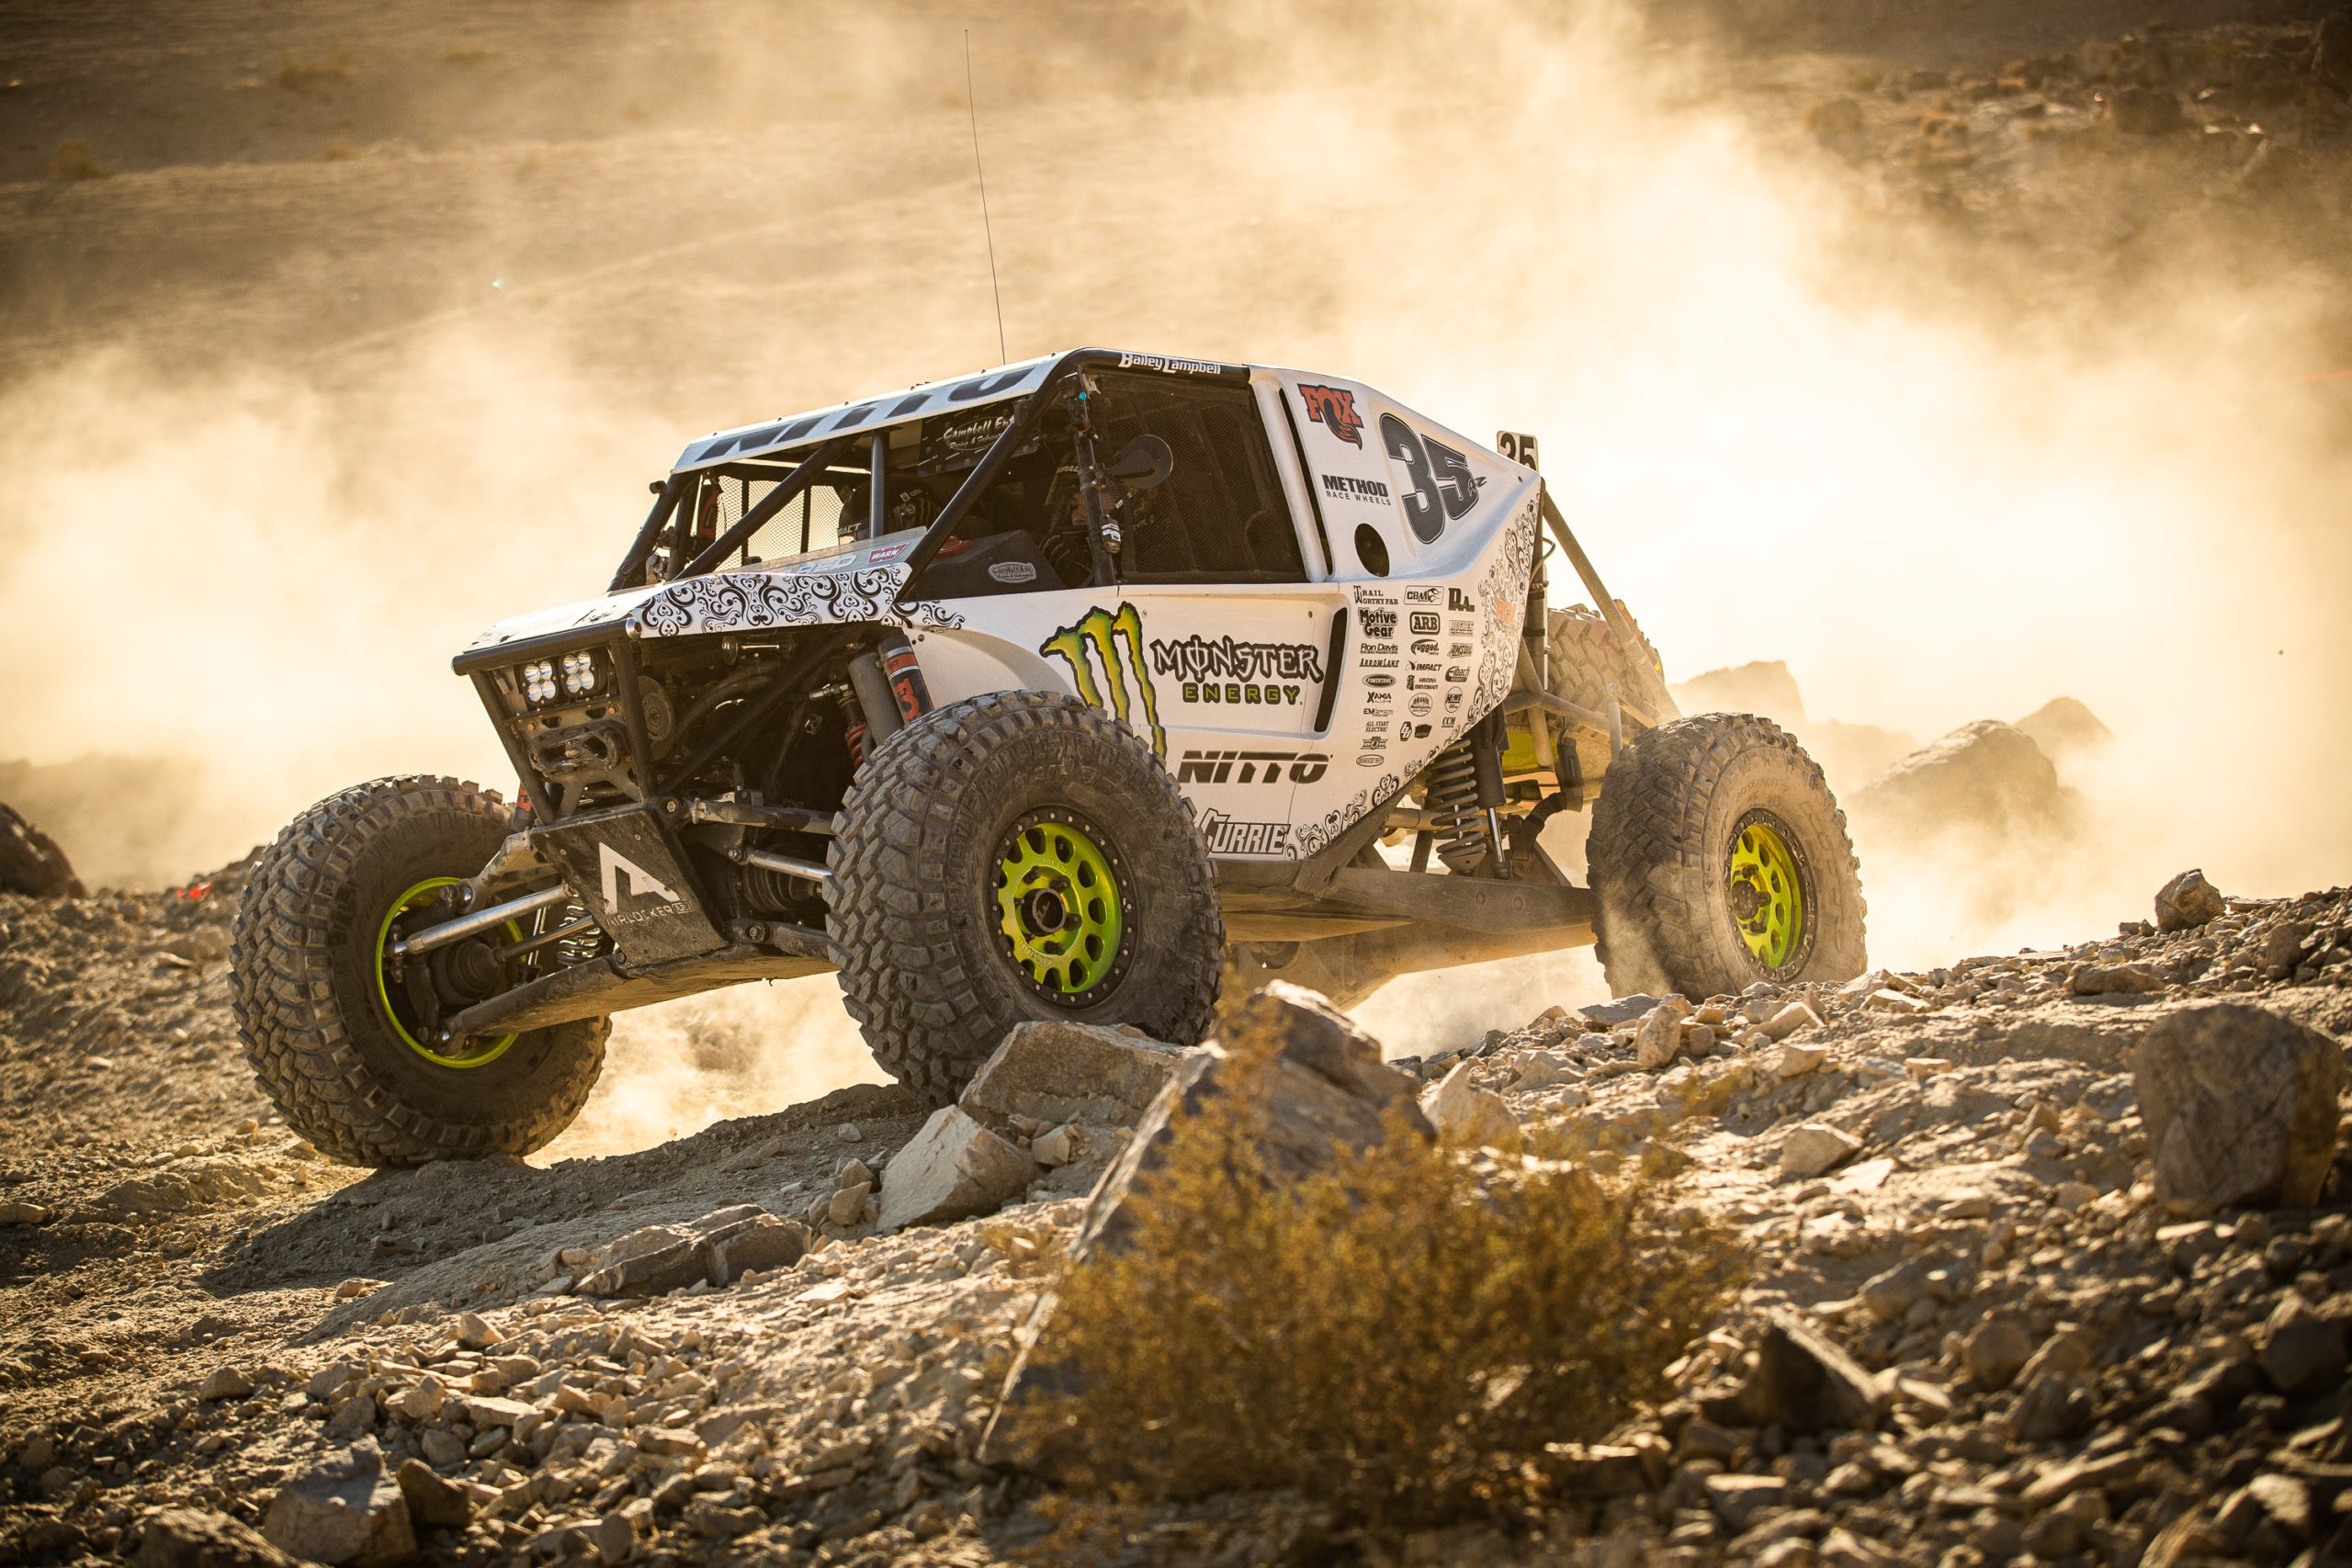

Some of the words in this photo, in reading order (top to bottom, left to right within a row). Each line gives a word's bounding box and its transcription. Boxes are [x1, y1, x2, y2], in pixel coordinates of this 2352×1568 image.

[1118, 353, 1162, 370] Bailey
[1297, 383, 1363, 434] FOX
[944, 420, 992, 439] Campbell
[1321, 474, 1388, 497] METHOD
[1379, 412, 1479, 544] 35
[1326, 491, 1351, 500] RACE
[1354, 493, 1391, 506] WHEELS
[1359, 609, 1397, 625] Motive
[1413, 615, 1438, 631] ARB
[1364, 623, 1394, 637] Gear
[1360, 643, 1376, 651] Ron
[1377, 643, 1398, 651] Davis
[1149, 635, 1324, 683] MONSTER
[1182, 682, 1300, 705] ENERGY
[1177, 750, 1329, 784] NITTO
[1197, 807, 1291, 854] CURRIE
